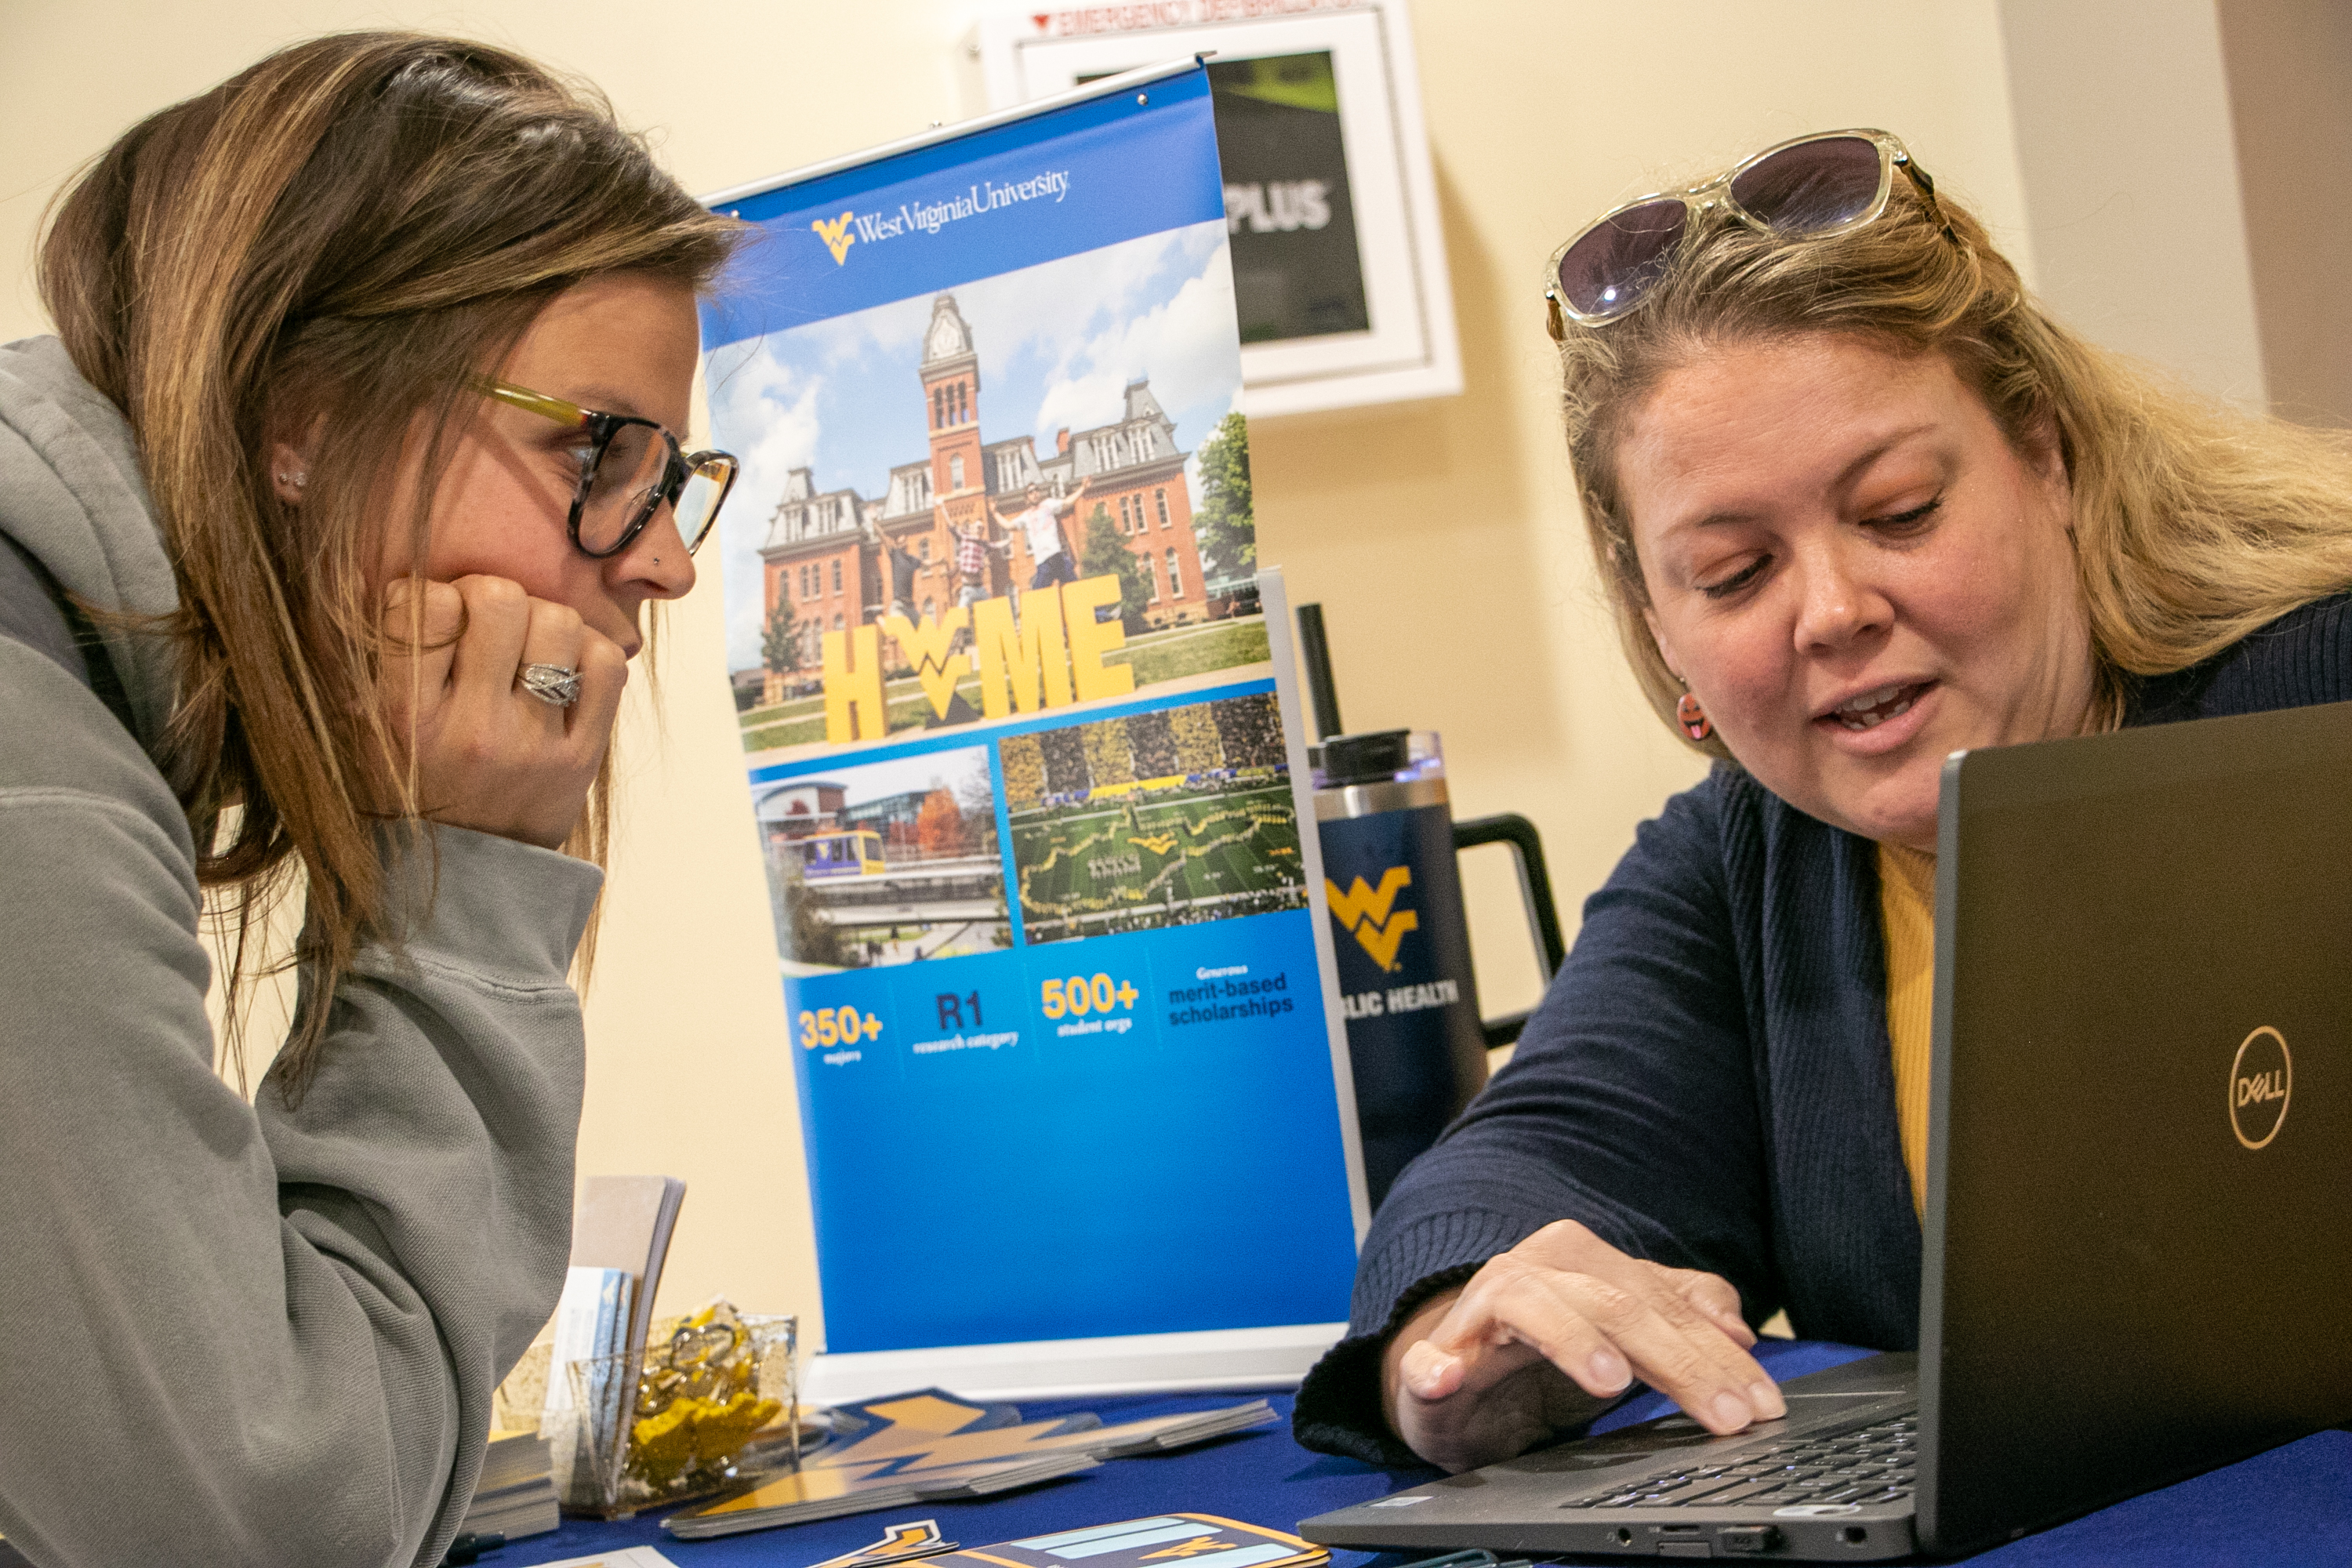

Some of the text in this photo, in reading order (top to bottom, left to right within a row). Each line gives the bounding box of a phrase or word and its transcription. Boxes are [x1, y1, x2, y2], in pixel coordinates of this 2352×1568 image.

[855, 170, 1069, 244] West Virginia University
[1223, 179, 1331, 234] PLUS
[1041, 972, 1140, 1020] 500+
[1169, 971, 1287, 1004] merit-based
[1341, 979, 1459, 1019] LIC HEALTH
[798, 1005, 884, 1050] 350+
[935, 989, 983, 1031] R1
[1169, 996, 1294, 1026] scholarships
[2237, 1069, 2285, 1108] DELL
